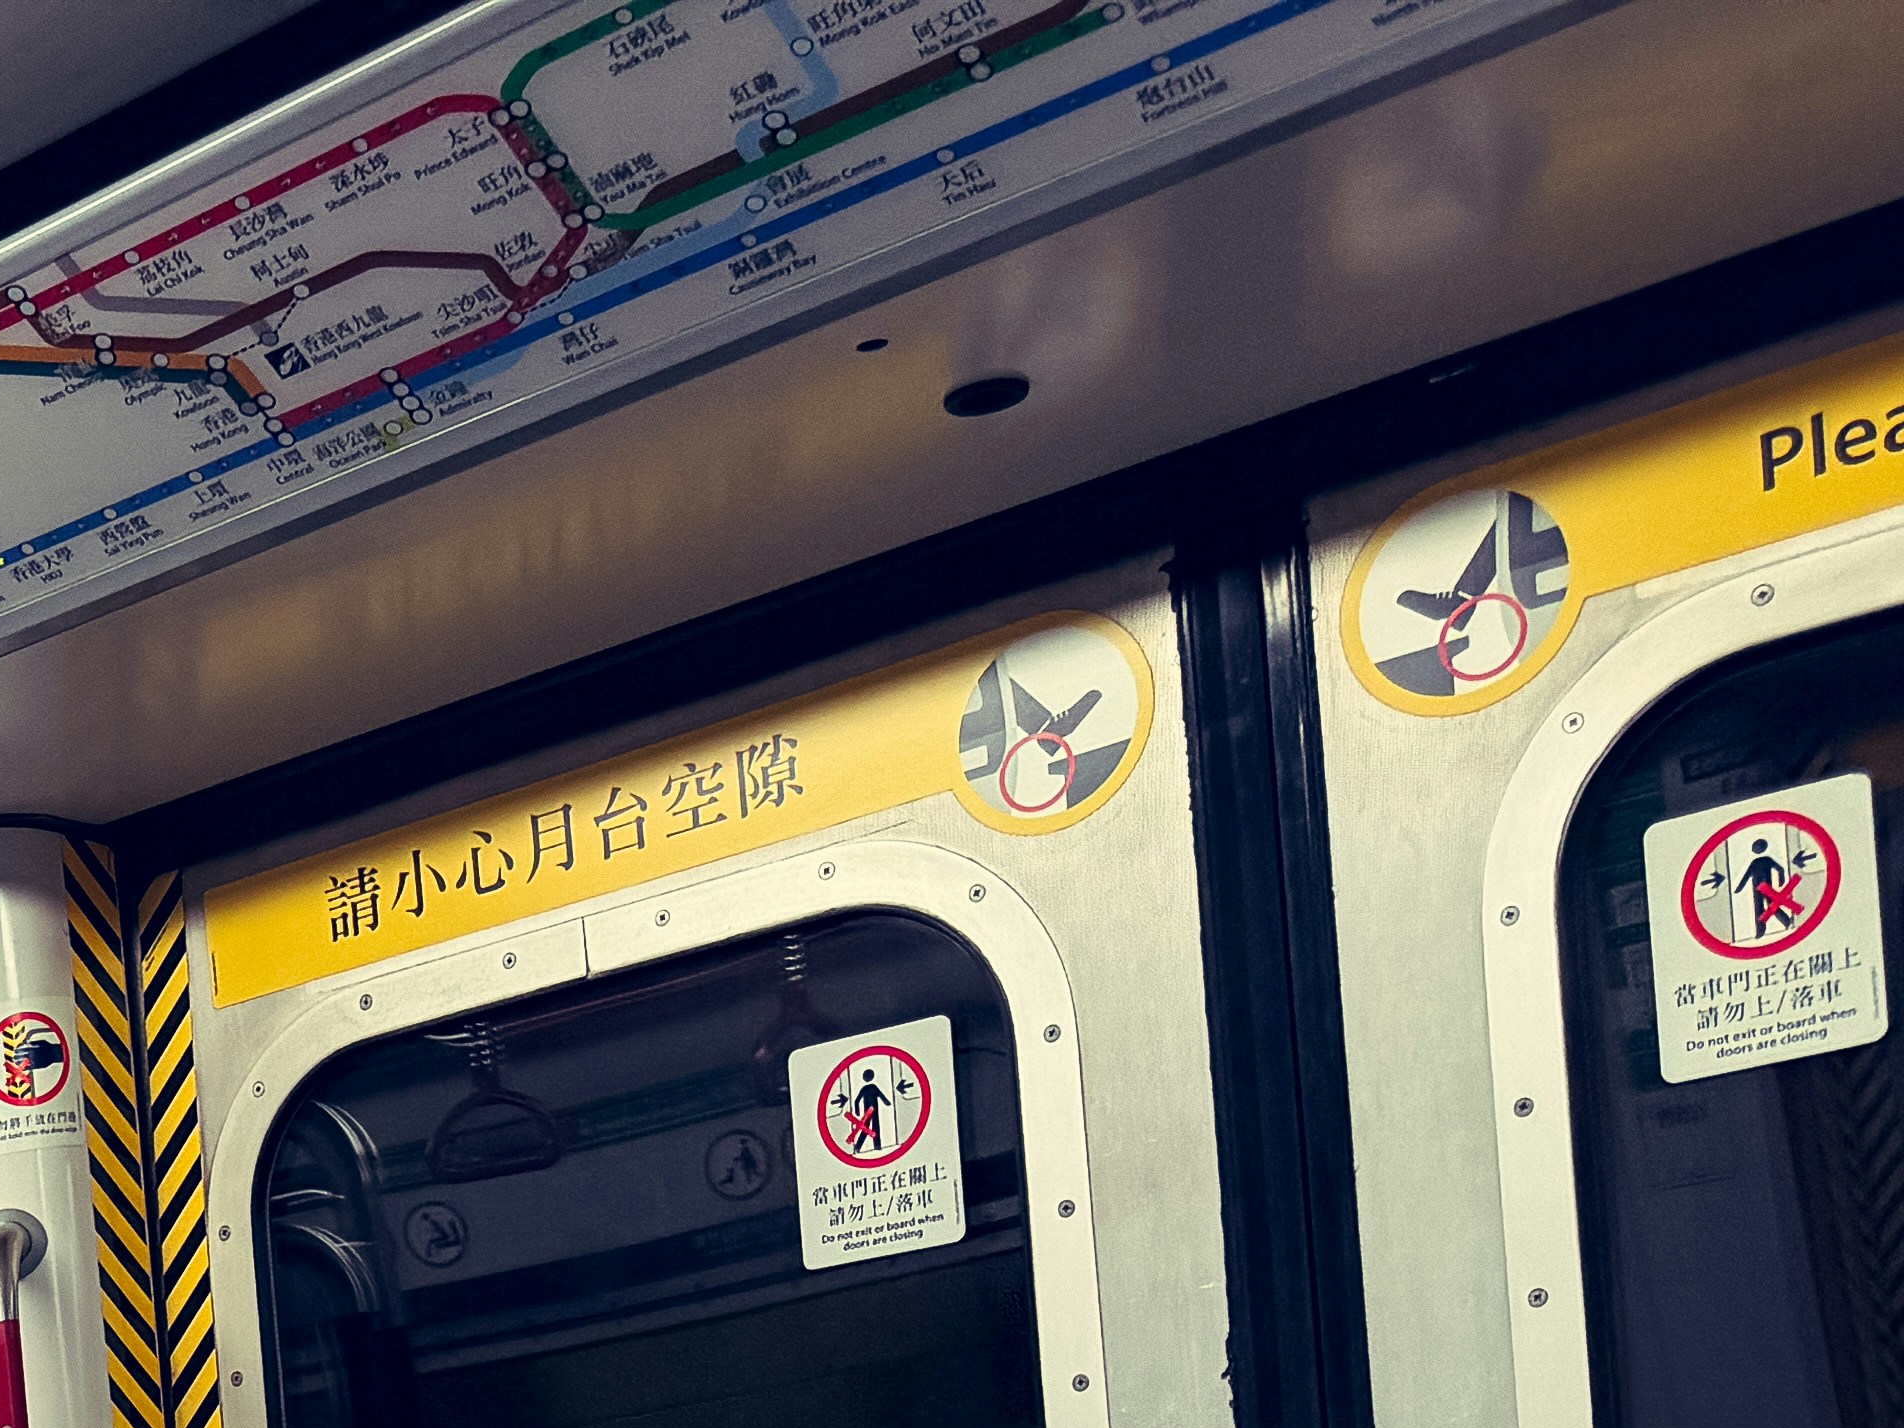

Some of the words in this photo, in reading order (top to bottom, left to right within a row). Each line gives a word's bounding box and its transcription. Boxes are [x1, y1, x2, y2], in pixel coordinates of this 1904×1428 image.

[326, 733, 805, 944] 請小心月台空隙
[1673, 947, 1862, 1007] 當車門正在關上
[1697, 979, 1843, 1031] 請勿上/落車
[1686, 1040, 1705, 1052] Do
[1708, 1034, 1729, 1047] not
[1733, 1028, 1757, 1042] exit
[1759, 1026, 1773, 1036] or
[1777, 1015, 1817, 1032] board
[1819, 1007, 1857, 1023] when
[1716, 1044, 1753, 1059] doors
[1756, 1040, 1777, 1051] are
[1780, 1027, 1828, 1046] closing
[812, 1162, 947, 1206] 當車門正在關上
[821, 1234, 835, 1244] Do
[837, 1230, 853, 1241] not
[855, 1226, 873, 1237] exit
[874, 1225, 885, 1234] or
[886, 1217, 916, 1232] board
[917, 1213, 945, 1225] when
[829, 1188, 934, 1227] 請勿上/落車
[843, 1239, 870, 1251] doors
[872, 1235, 887, 1246] are
[889, 1228, 924, 1241] closing
